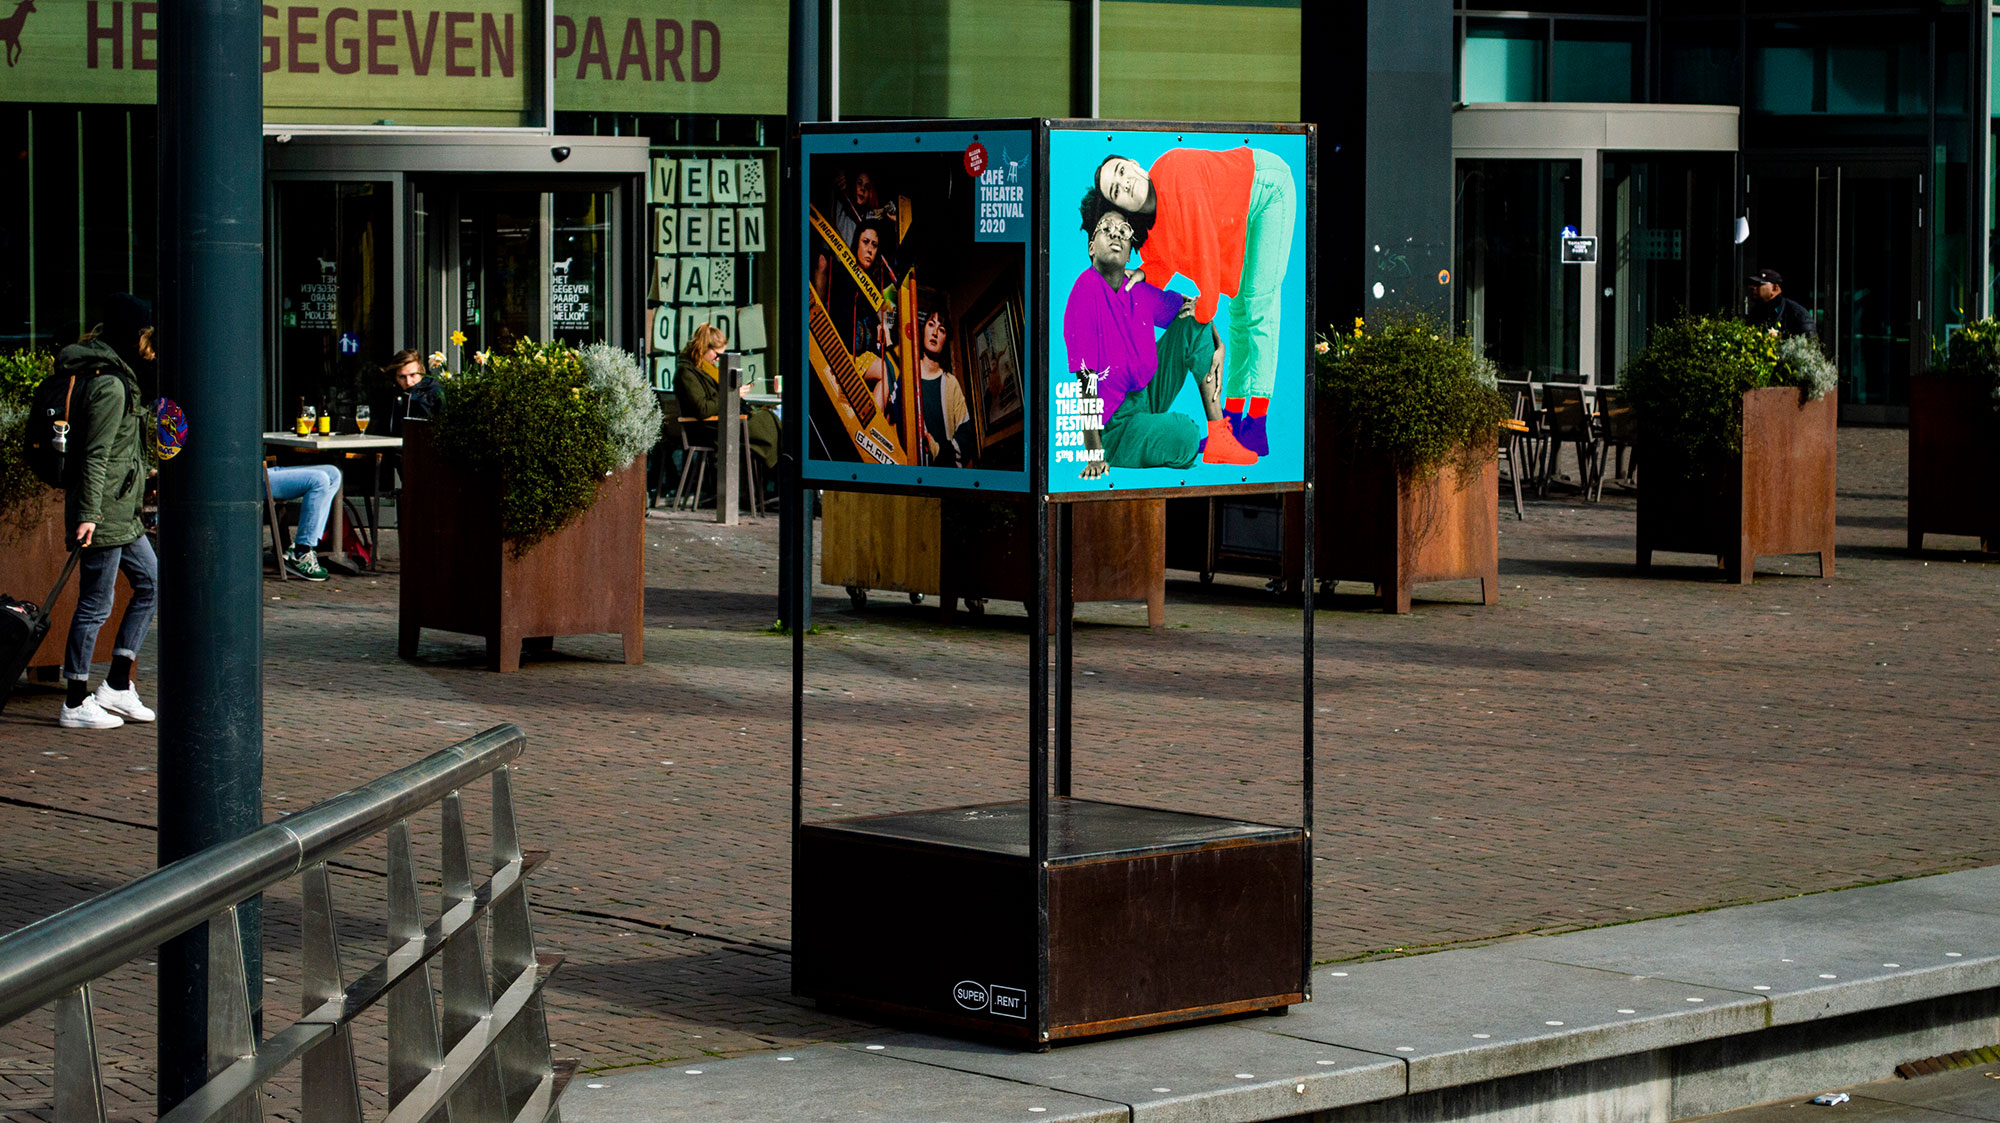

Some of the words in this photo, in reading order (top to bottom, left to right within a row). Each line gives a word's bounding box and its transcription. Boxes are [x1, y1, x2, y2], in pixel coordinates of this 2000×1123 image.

[87, 1, 157, 70] HE
[554, 15, 721, 82] PAARD
[661, 167, 731, 197] VER
[980, 166, 1004, 185] CAFÉ
[980, 186, 1024, 201] THEATER
[980, 202, 1024, 218] FESTIVAL
[662, 215, 760, 246] SEEN
[980, 219, 1005, 233] 2020
[818, 221, 843, 252] INGANG
[552, 275, 569, 284] HET
[685, 266, 704, 296] A
[552, 284, 589, 294] GEGEVEN
[552, 294, 580, 303] PAARD
[553, 303, 574, 312] HEET
[578, 303, 589, 312] JE
[553, 312, 586, 321] WELKOM
[1055, 379, 1083, 399] CAFÉ
[1055, 398, 1104, 415] THEATER
[1056, 415, 1105, 431] FESTIVAL
[1055, 431, 1085, 447] 2020
[1075, 449, 1105, 462] MAART
[957, 988, 985, 1003] SUPER
